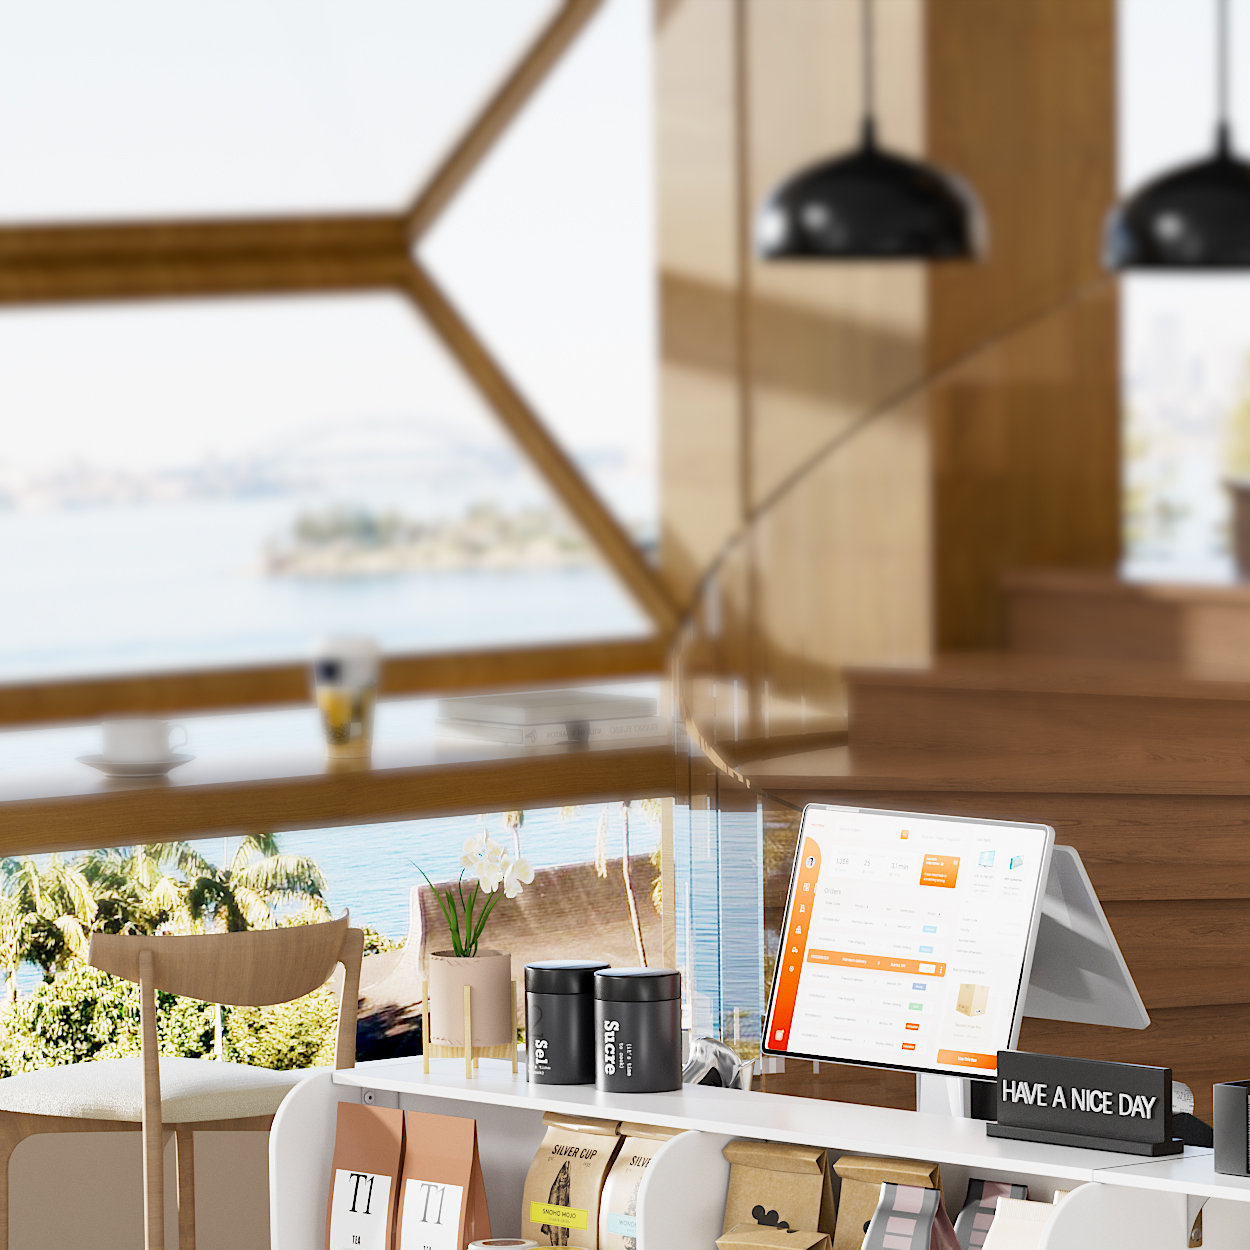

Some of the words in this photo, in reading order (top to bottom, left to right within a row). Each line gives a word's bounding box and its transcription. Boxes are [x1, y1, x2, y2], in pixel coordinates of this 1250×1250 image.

[604, 1020, 620, 1075] Sucre
[1002, 1079, 1048, 1107] HAVE
[1052, 1085, 1068, 1109] A
[1071, 1086, 1113, 1115] NICE
[1118, 1092, 1157, 1120] DAY
[552, 1144, 579, 1158] SILVER
[580, 1148, 598, 1160] CUP
[352, 1235, 361, 1245] TEA
